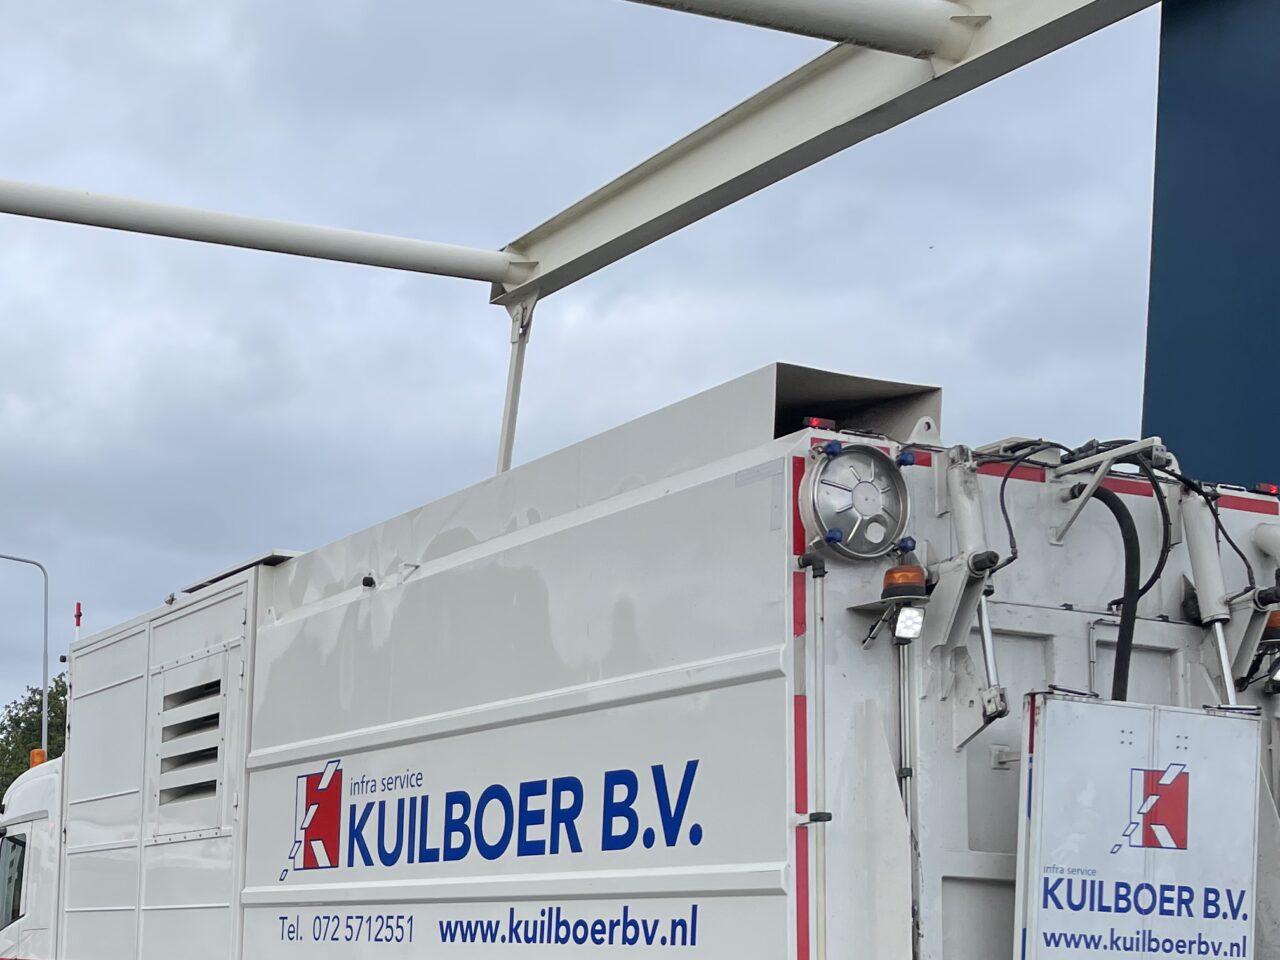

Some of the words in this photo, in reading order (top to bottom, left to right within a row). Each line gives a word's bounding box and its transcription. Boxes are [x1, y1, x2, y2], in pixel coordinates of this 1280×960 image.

[350, 774, 377, 796] infra
[381, 768, 424, 792] service
[347, 776, 584, 868] KUILBOER
[601, 759, 703, 851] B.V.
[1043, 864, 1065, 875] infra
[1067, 866, 1097, 877] service
[1042, 877, 1195, 918] KUILBOER
[1203, 887, 1249, 921] B.V.
[279, 915, 303, 941] Tel.
[312, 915, 340, 942] 072
[344, 915, 414, 943] 5712551
[439, 904, 698, 946] www.kuilboerbv.nl
[1043, 928, 1247, 958] www.kuilboerbv.nl
